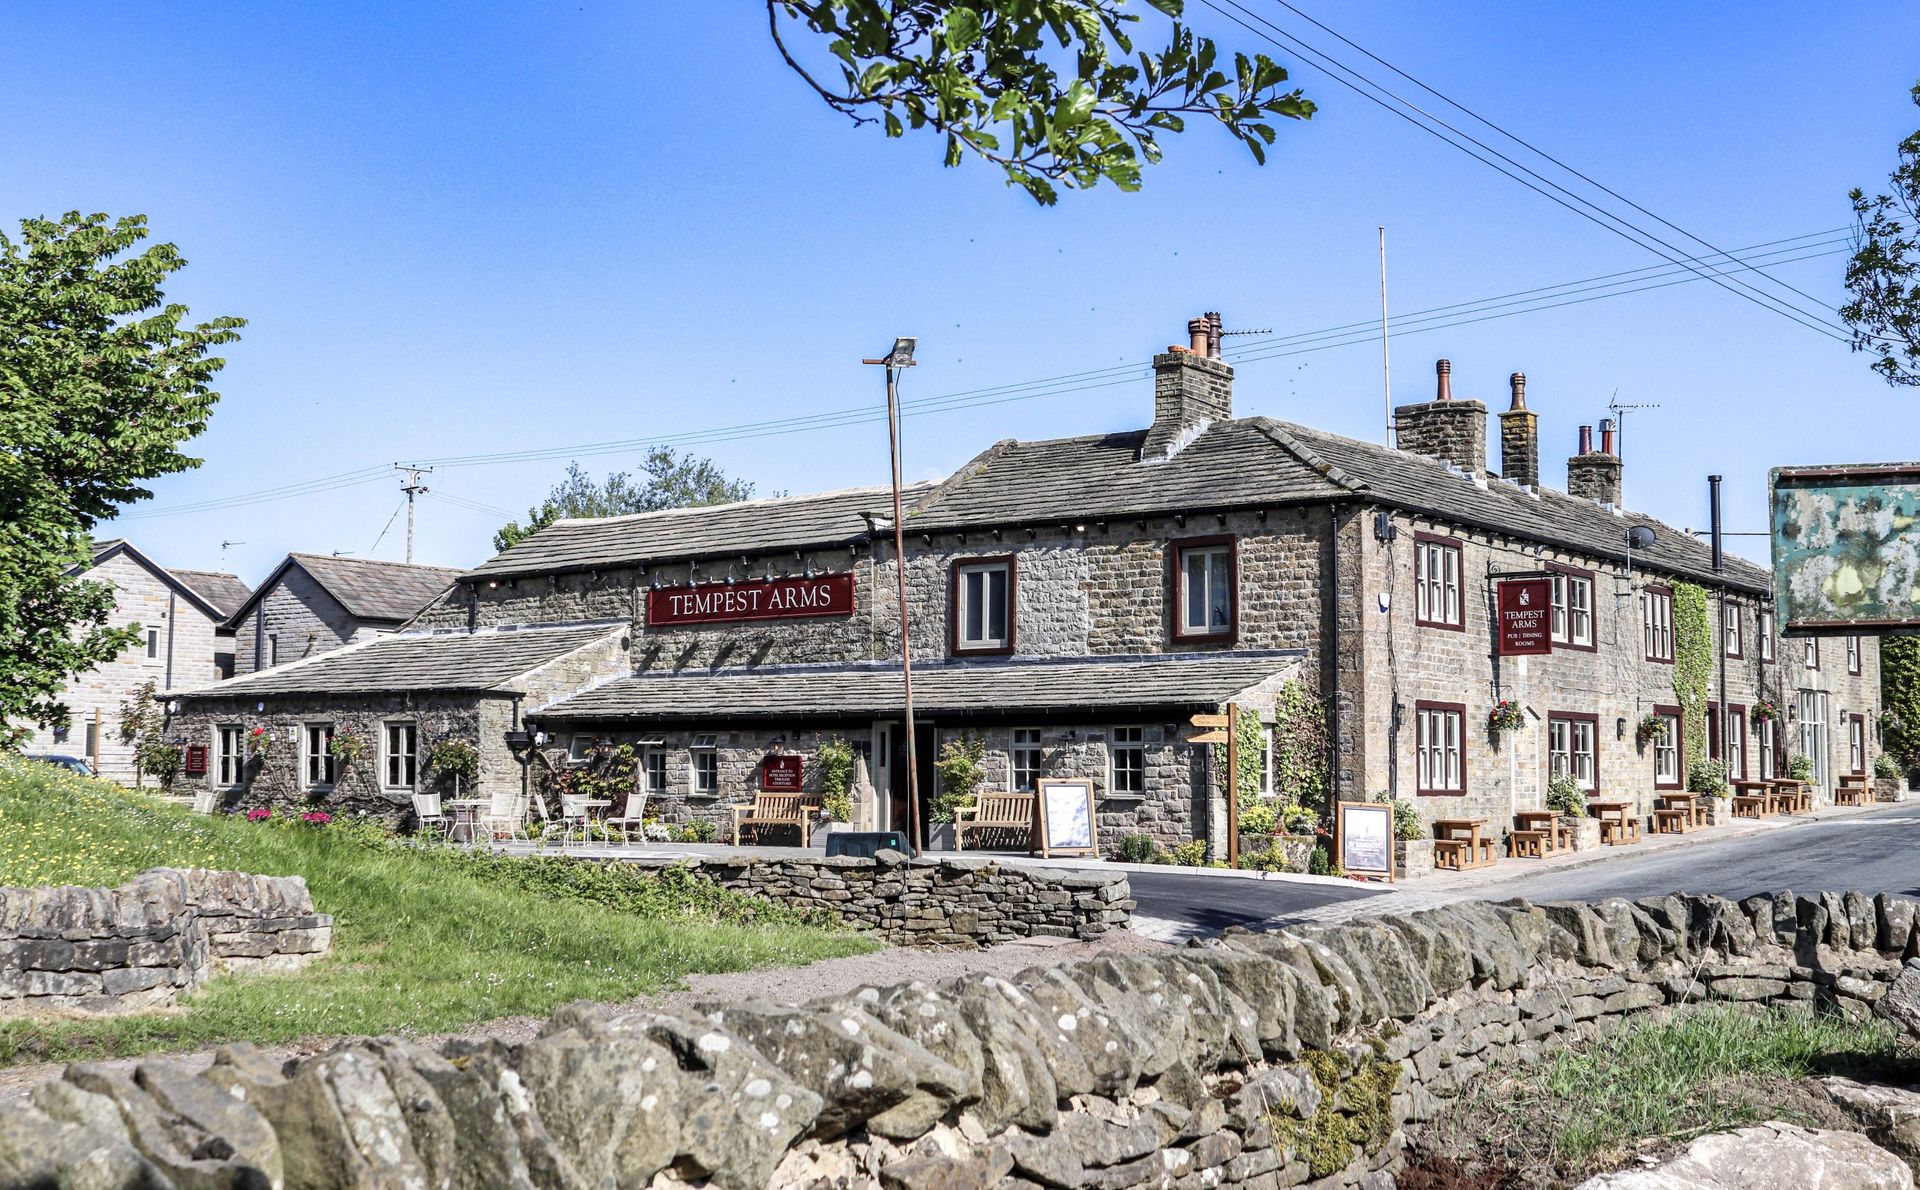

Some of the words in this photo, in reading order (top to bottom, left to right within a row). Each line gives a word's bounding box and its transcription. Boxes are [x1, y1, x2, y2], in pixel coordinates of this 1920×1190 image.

[669, 589, 762, 616] TEMPEST
[768, 584, 832, 609] ARMS
[1504, 610, 1545, 620] TEMPEST
[1512, 620, 1537, 629] ARMS
